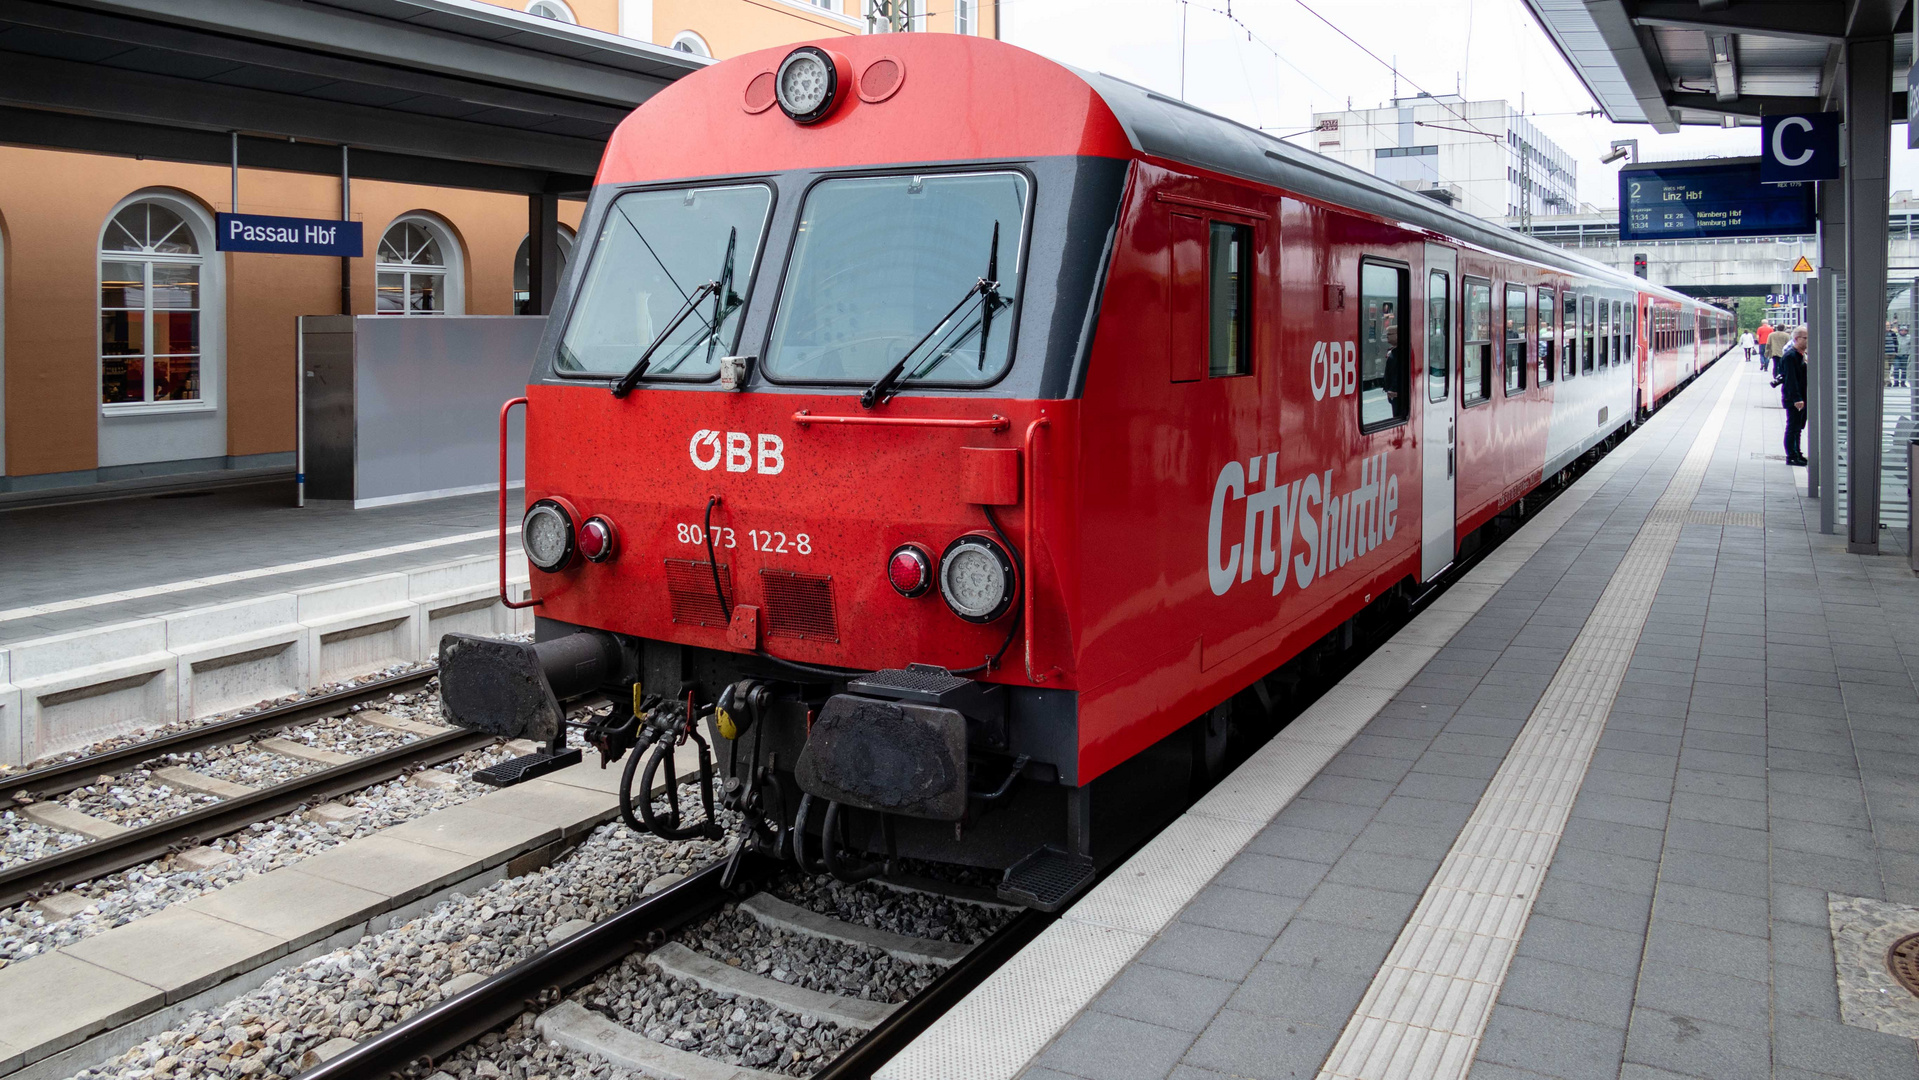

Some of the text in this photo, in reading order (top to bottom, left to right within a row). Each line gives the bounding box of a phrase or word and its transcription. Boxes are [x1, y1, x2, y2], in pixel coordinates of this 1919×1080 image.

[1772, 116, 1815, 167] C
[1630, 182, 1641, 199] 2
[1662, 190, 1703, 201] Linz Hbf
[230, 220, 336, 245] Passau Hbf
[1766, 294, 1773, 303] 2
[1778, 294, 1785, 303] B
[1310, 340, 1357, 402] ÖBB
[689, 429, 785, 475] ÖBB
[1207, 451, 1399, 597] CityShuttle
[748, 529, 812, 555] 122-8
